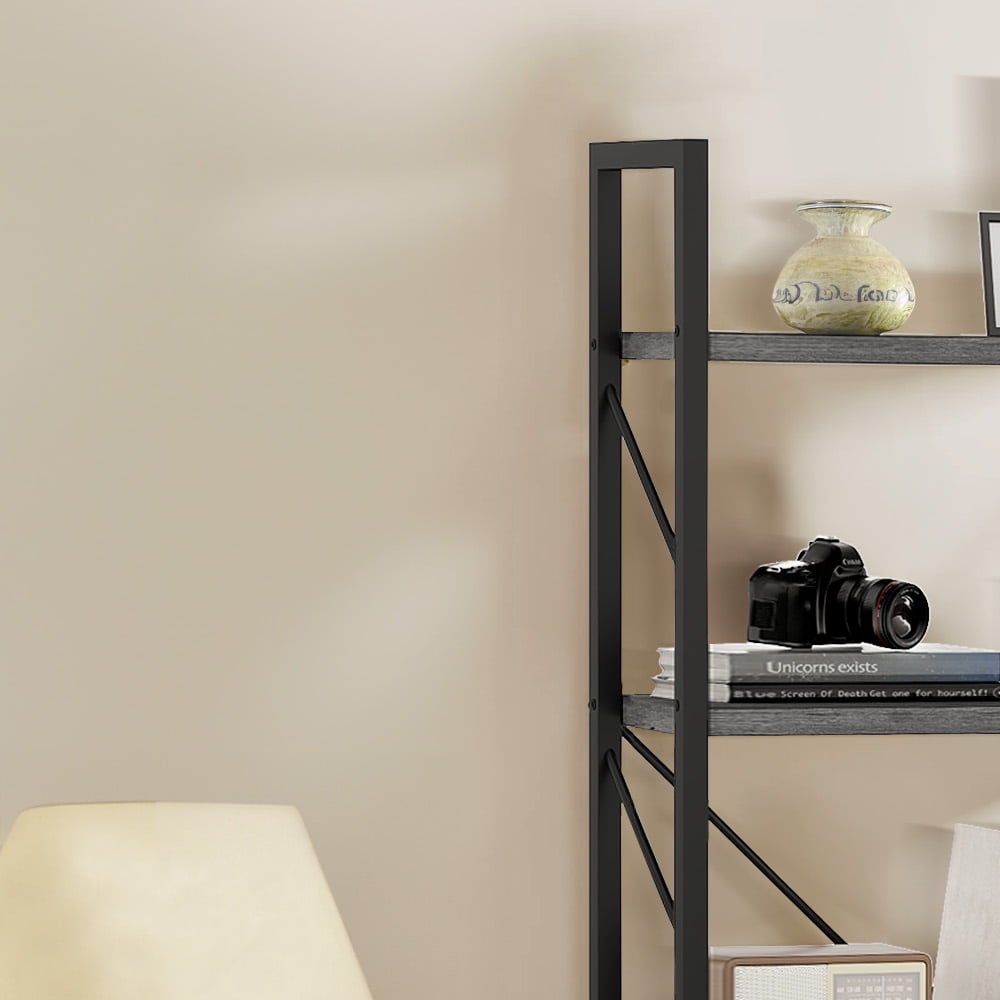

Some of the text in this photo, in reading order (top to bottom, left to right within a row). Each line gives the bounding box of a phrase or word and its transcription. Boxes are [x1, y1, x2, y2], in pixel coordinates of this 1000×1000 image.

[766, 661, 878, 674] Unicorns exists
[733, 690, 777, 698] Blue
[780, 689, 816, 698] Screen
[820, 689, 832, 698] Of
[838, 689, 867, 698] Death
[869, 689, 887, 698] Get
[892, 690, 910, 698] one
[915, 689, 933, 698] for
